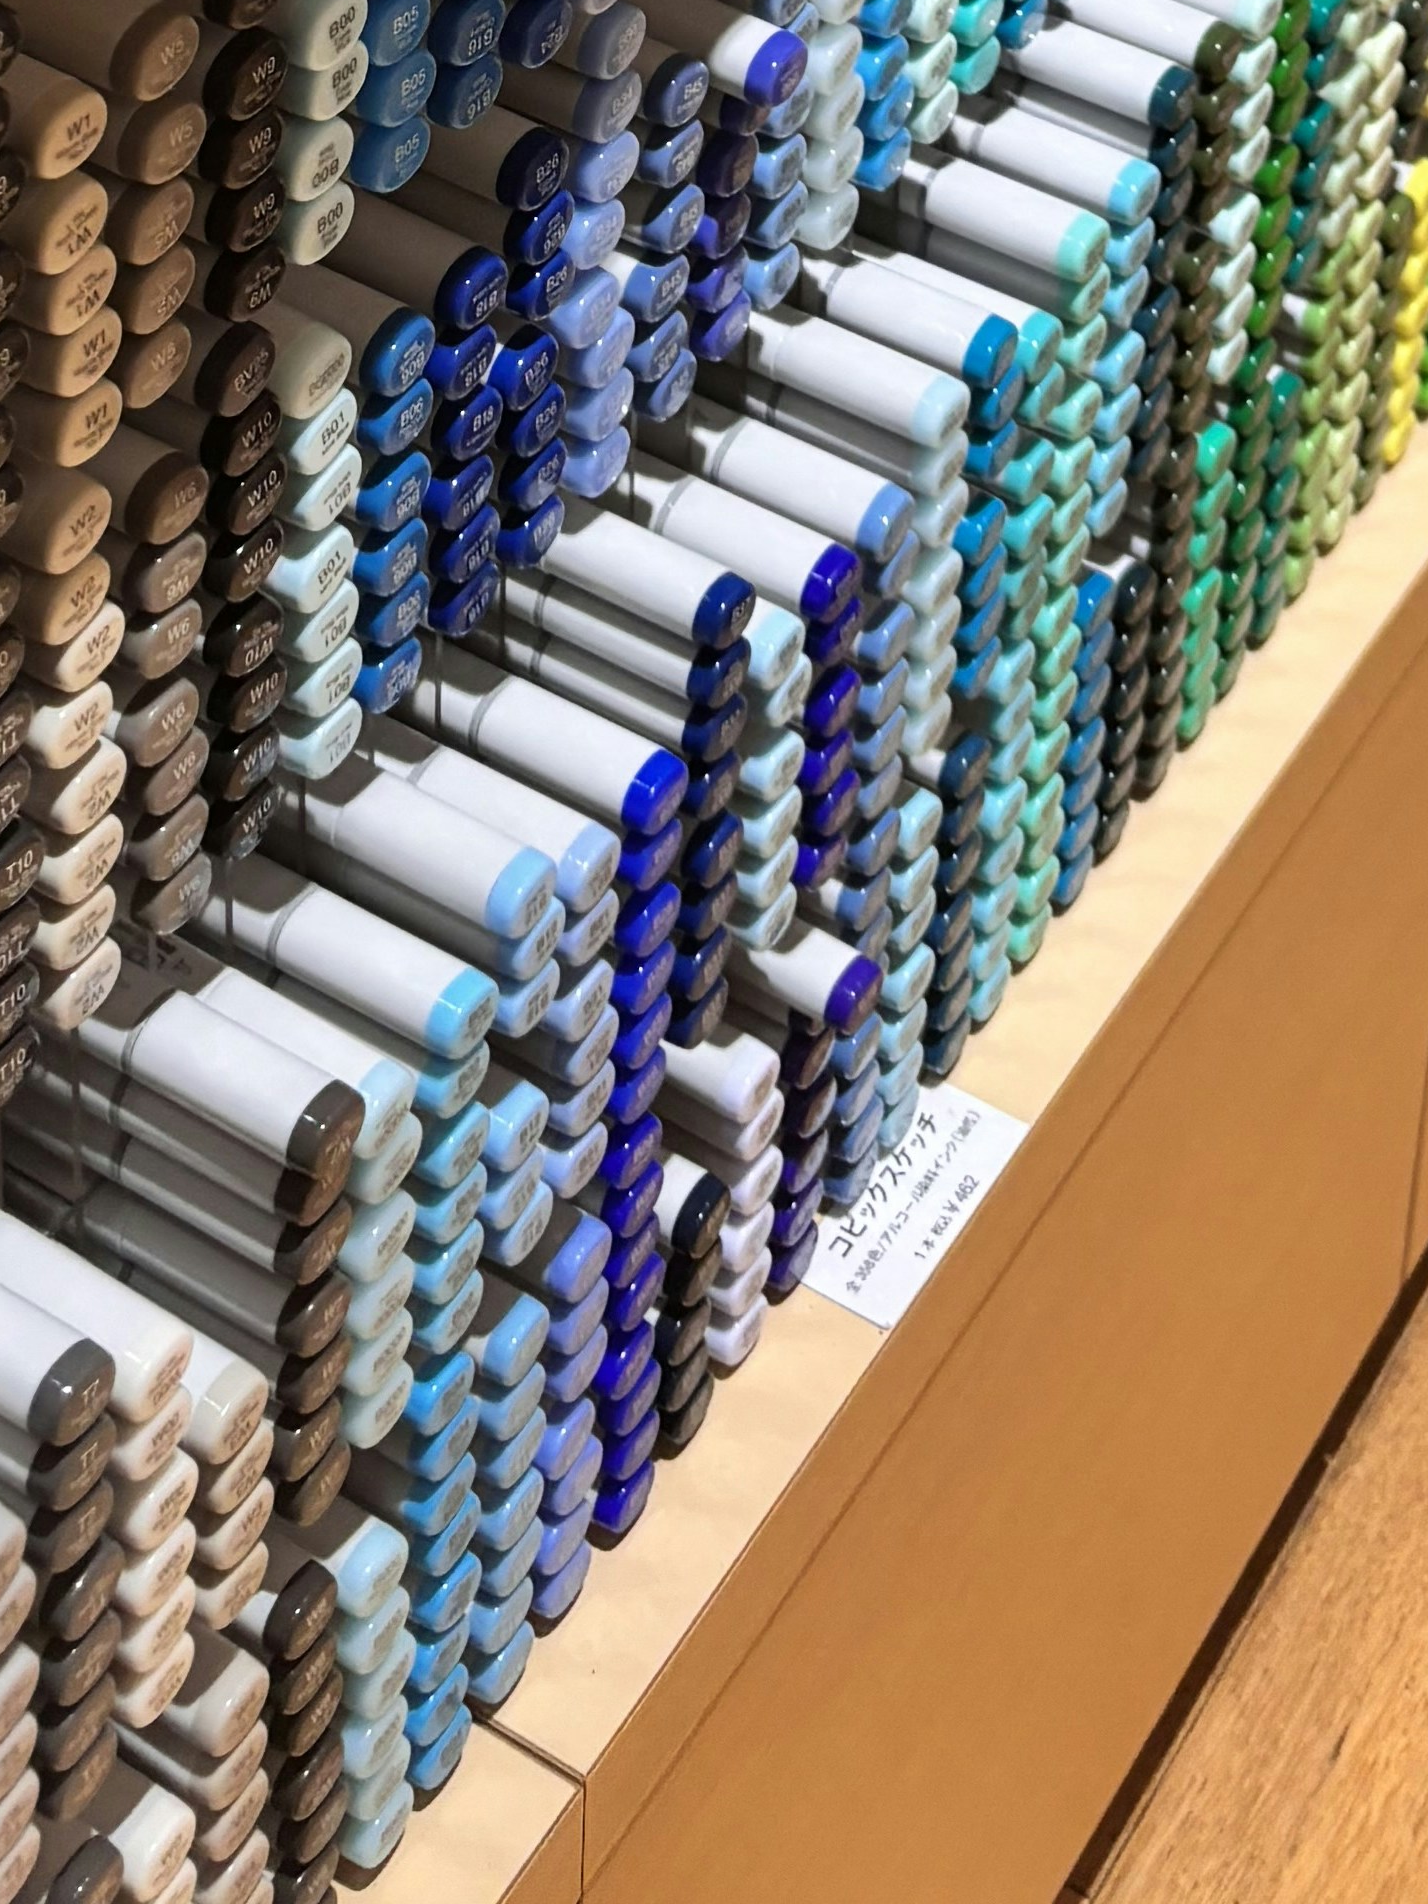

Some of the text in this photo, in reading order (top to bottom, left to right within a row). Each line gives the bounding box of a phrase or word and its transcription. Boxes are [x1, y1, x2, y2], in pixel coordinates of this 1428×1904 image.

[329, 6, 356, 39] B00
[394, 5, 418, 35] B05
[332, 57, 357, 88] B00
[401, 69, 426, 97] B05
[249, 127, 272, 154] W9
[394, 135, 419, 163] B05
[317, 202, 344, 234] B00
[320, 410, 346, 446] B01
[400, 399, 424, 429] B06
[241, 412, 272, 449] W10
[247, 470, 278, 507] W10
[70, 505, 96, 536] W2
[243, 539, 274, 575] W10
[317, 550, 342, 585] B01
[250, 672, 279, 706] W10
[73, 703, 99, 730] W2
[243, 737, 272, 773] W10
[242, 799, 271, 835] W10
[6, 849, 34, 881] T10
[828, 1112, 937, 1258] コピックスケッチ
